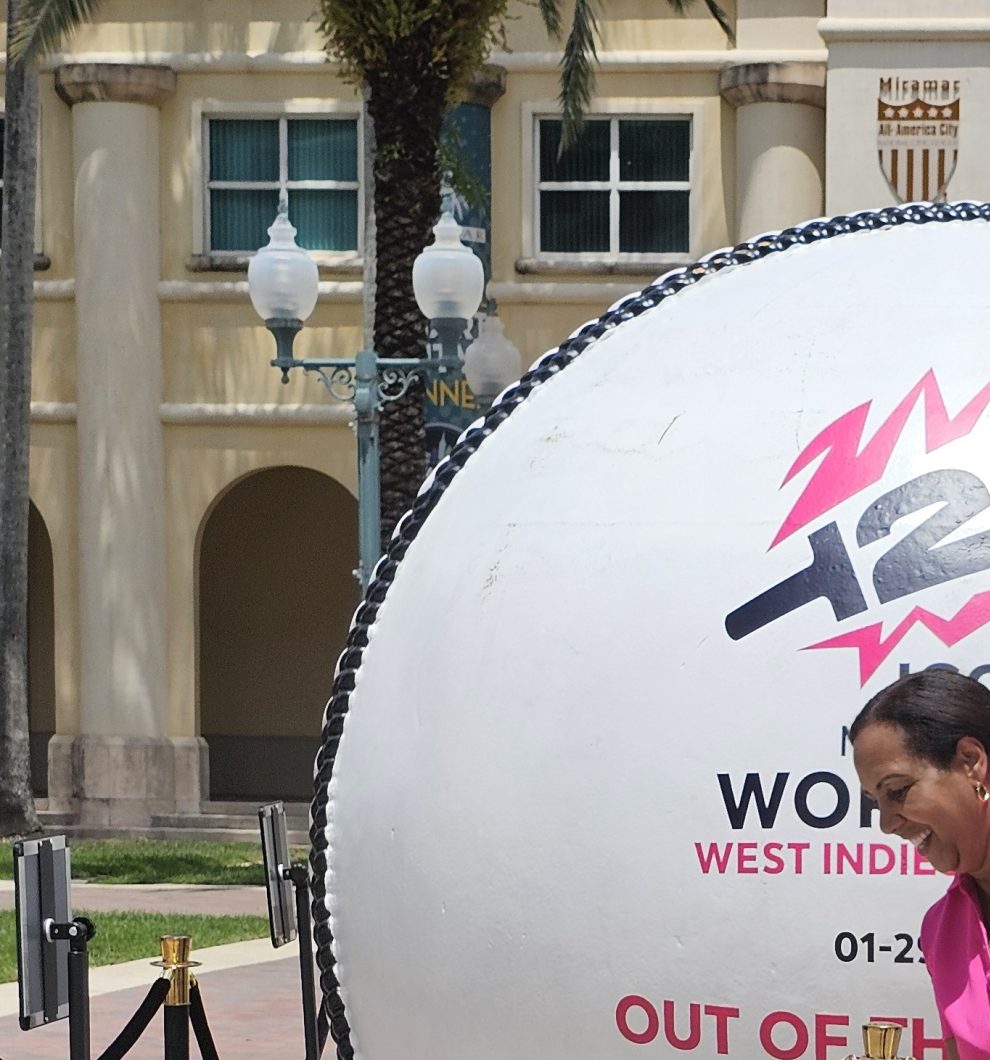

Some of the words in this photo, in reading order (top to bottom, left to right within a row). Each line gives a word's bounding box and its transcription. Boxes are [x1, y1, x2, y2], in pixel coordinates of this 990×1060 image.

[879, 77, 960, 92] Miramar
[695, 842, 811, 875] WEST
[823, 842, 952, 877] INDIE
[834, 931, 927, 964] 01-2
[615, 994, 740, 1056] OUT
